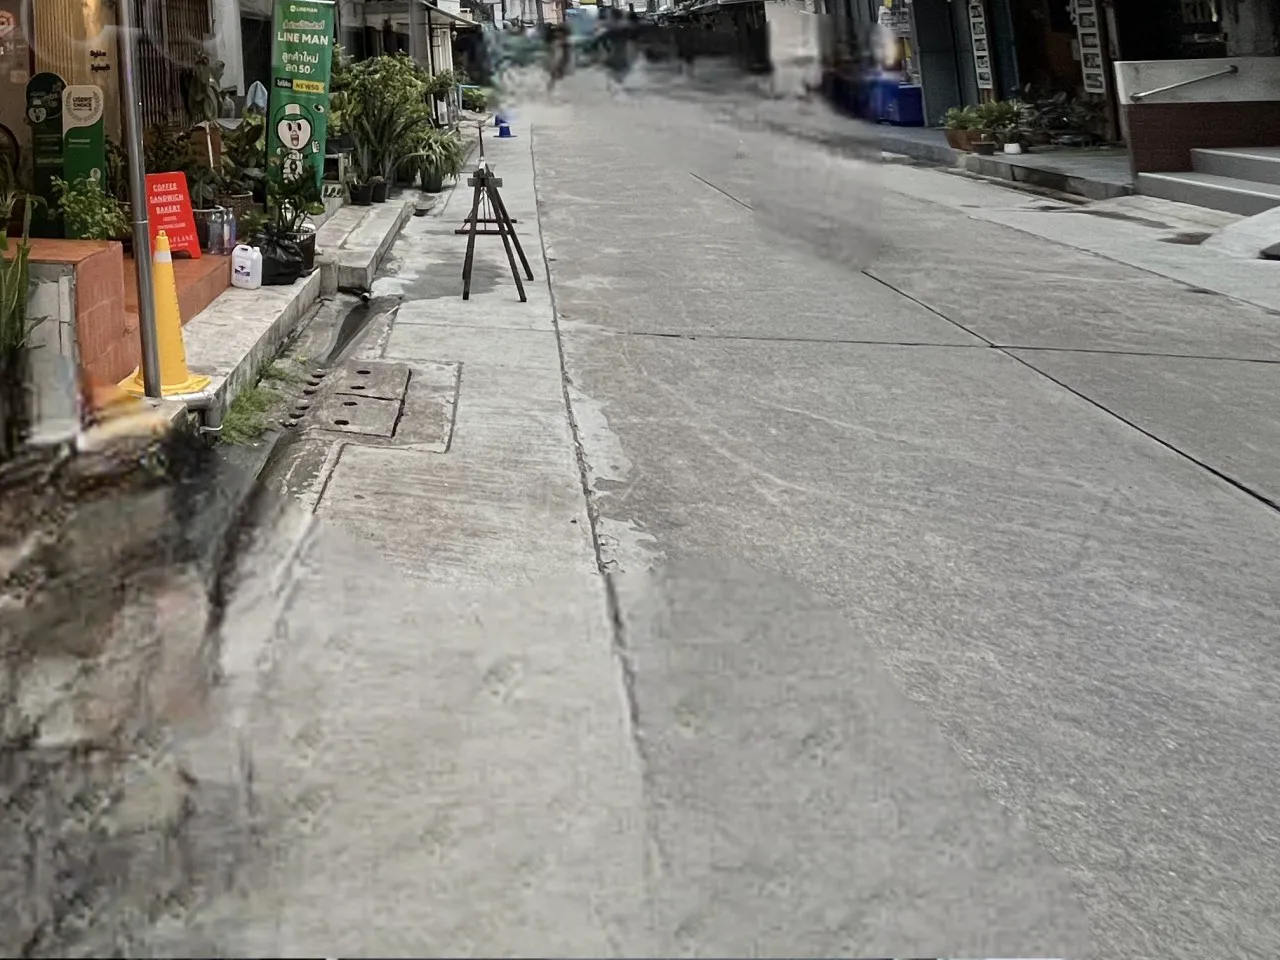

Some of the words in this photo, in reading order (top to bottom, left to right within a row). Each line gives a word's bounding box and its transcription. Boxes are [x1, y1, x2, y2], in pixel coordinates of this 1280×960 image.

[277, 31, 300, 43] LINE
[301, 33, 329, 45] MAN
[150, 194, 184, 204] SANDWICH
[156, 205, 181, 214] BAKERY
